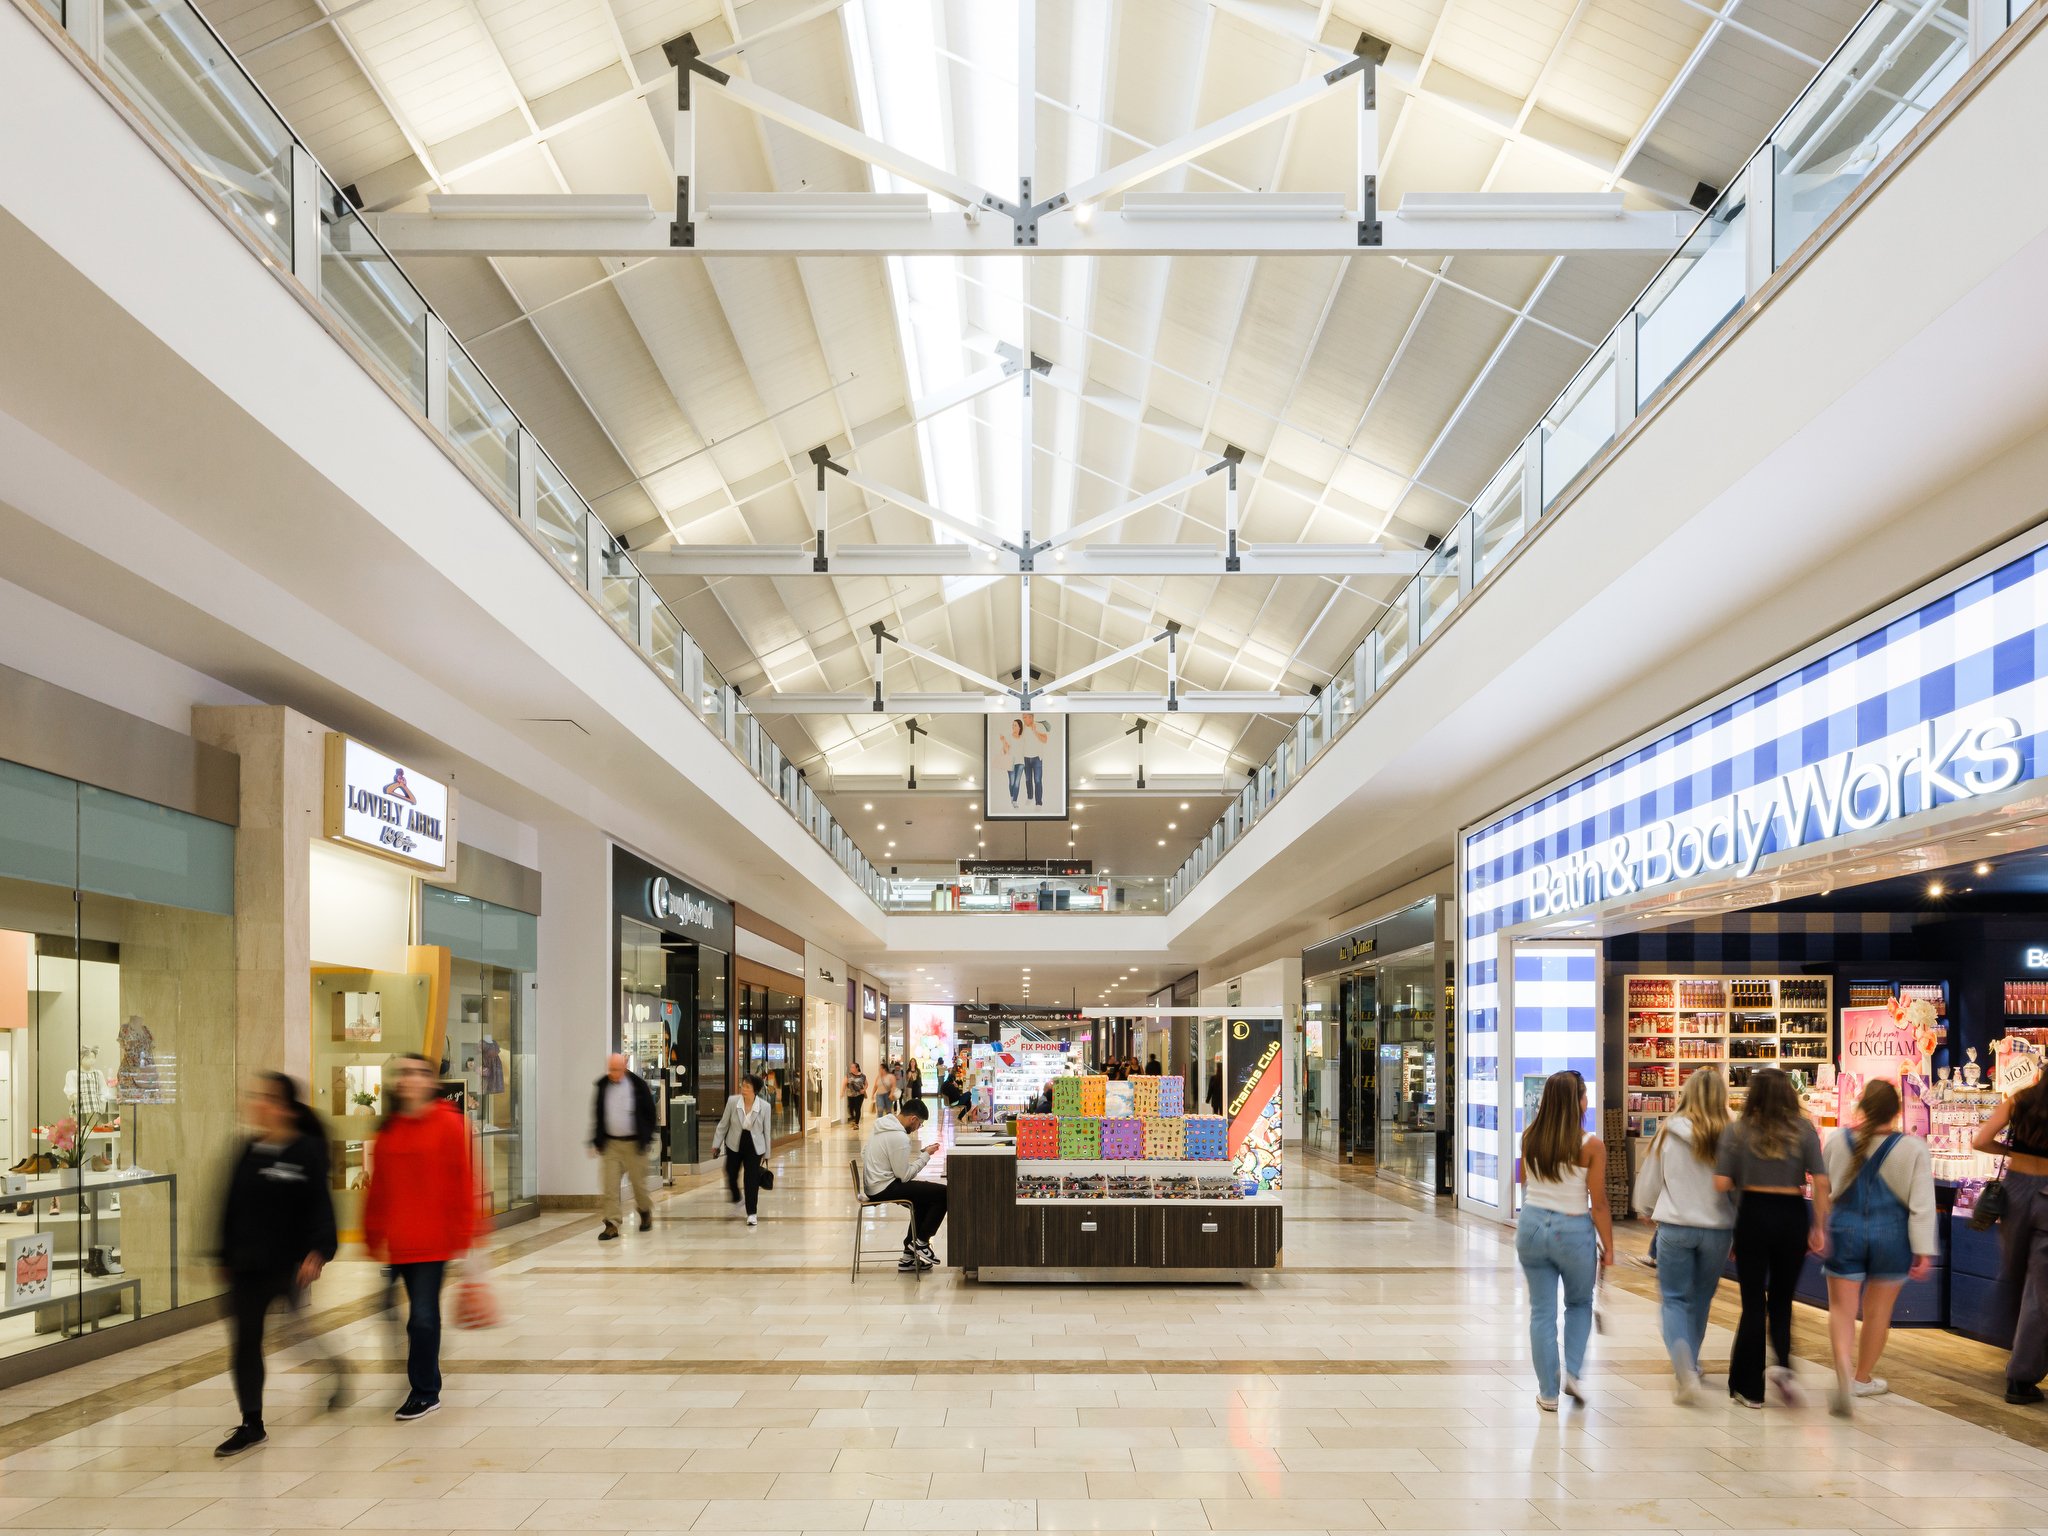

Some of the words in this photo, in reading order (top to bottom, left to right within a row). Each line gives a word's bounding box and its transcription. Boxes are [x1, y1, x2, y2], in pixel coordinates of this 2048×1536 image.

[347, 784, 403, 826] LOVELY
[406, 808, 443, 842] ABRIL
[1528, 850, 1604, 919] Bath
[1606, 835, 1640, 897] &
[1641, 795, 1777, 878] Body
[1782, 716, 2023, 847] Works
[1021, 1043, 1034, 1051] FIX
[1849, 1040, 1917, 1056] GINGHAM
[1228, 1069, 1263, 1116] Charms
[1257, 1040, 1281, 1069] Club
[2004, 1060, 2032, 1082] MOM
